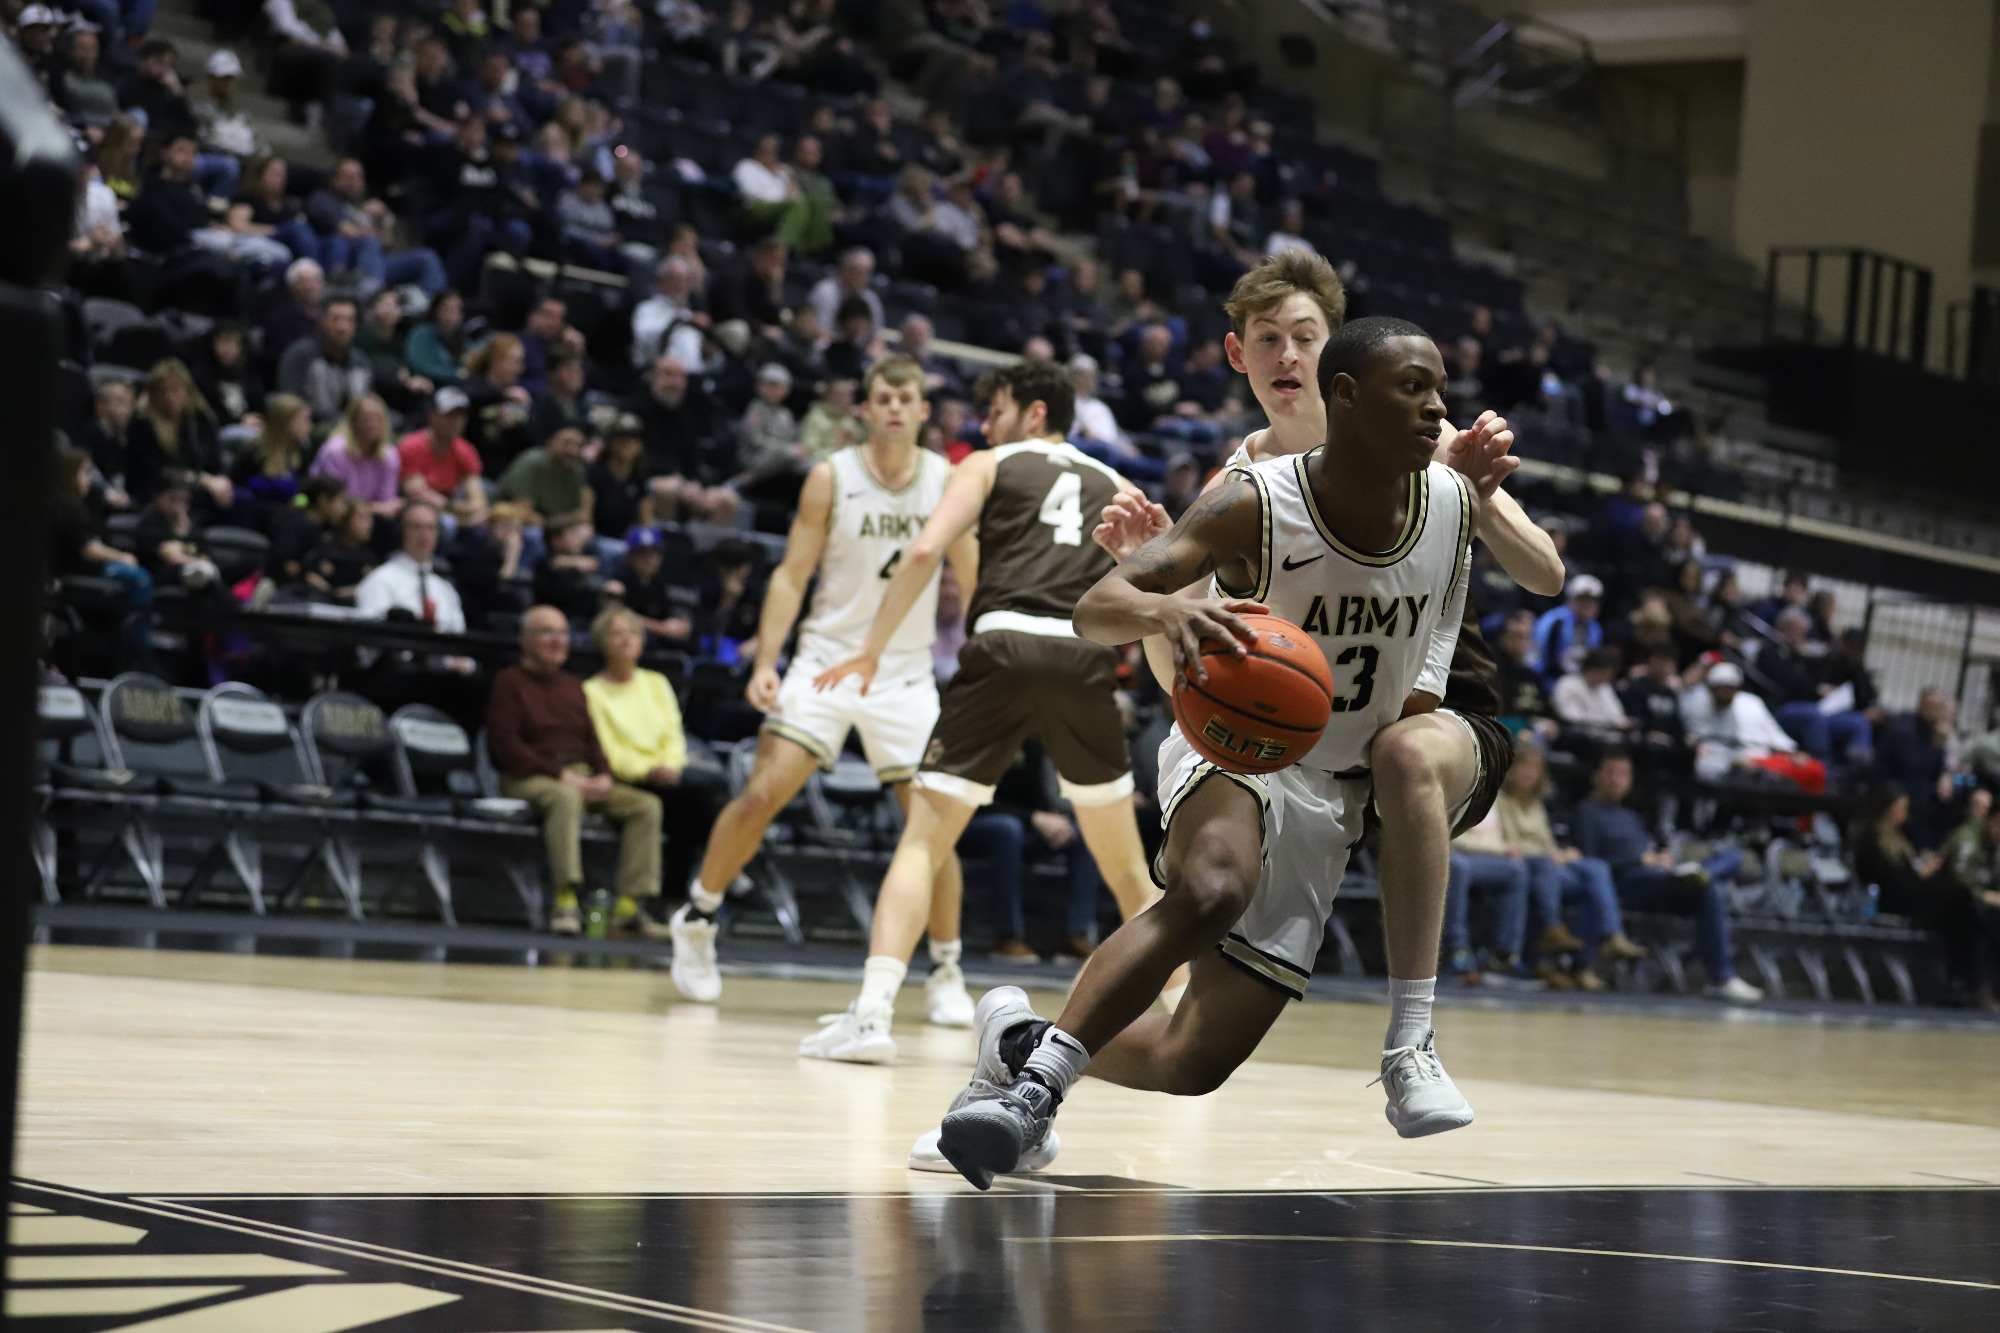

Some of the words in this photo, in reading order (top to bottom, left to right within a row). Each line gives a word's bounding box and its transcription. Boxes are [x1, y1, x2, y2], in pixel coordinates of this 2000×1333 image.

[1038, 471, 1084, 547] 4
[1300, 593, 1430, 638] ARMY
[1332, 645, 1380, 713] 3
[1202, 717, 1289, 762] ELITE
